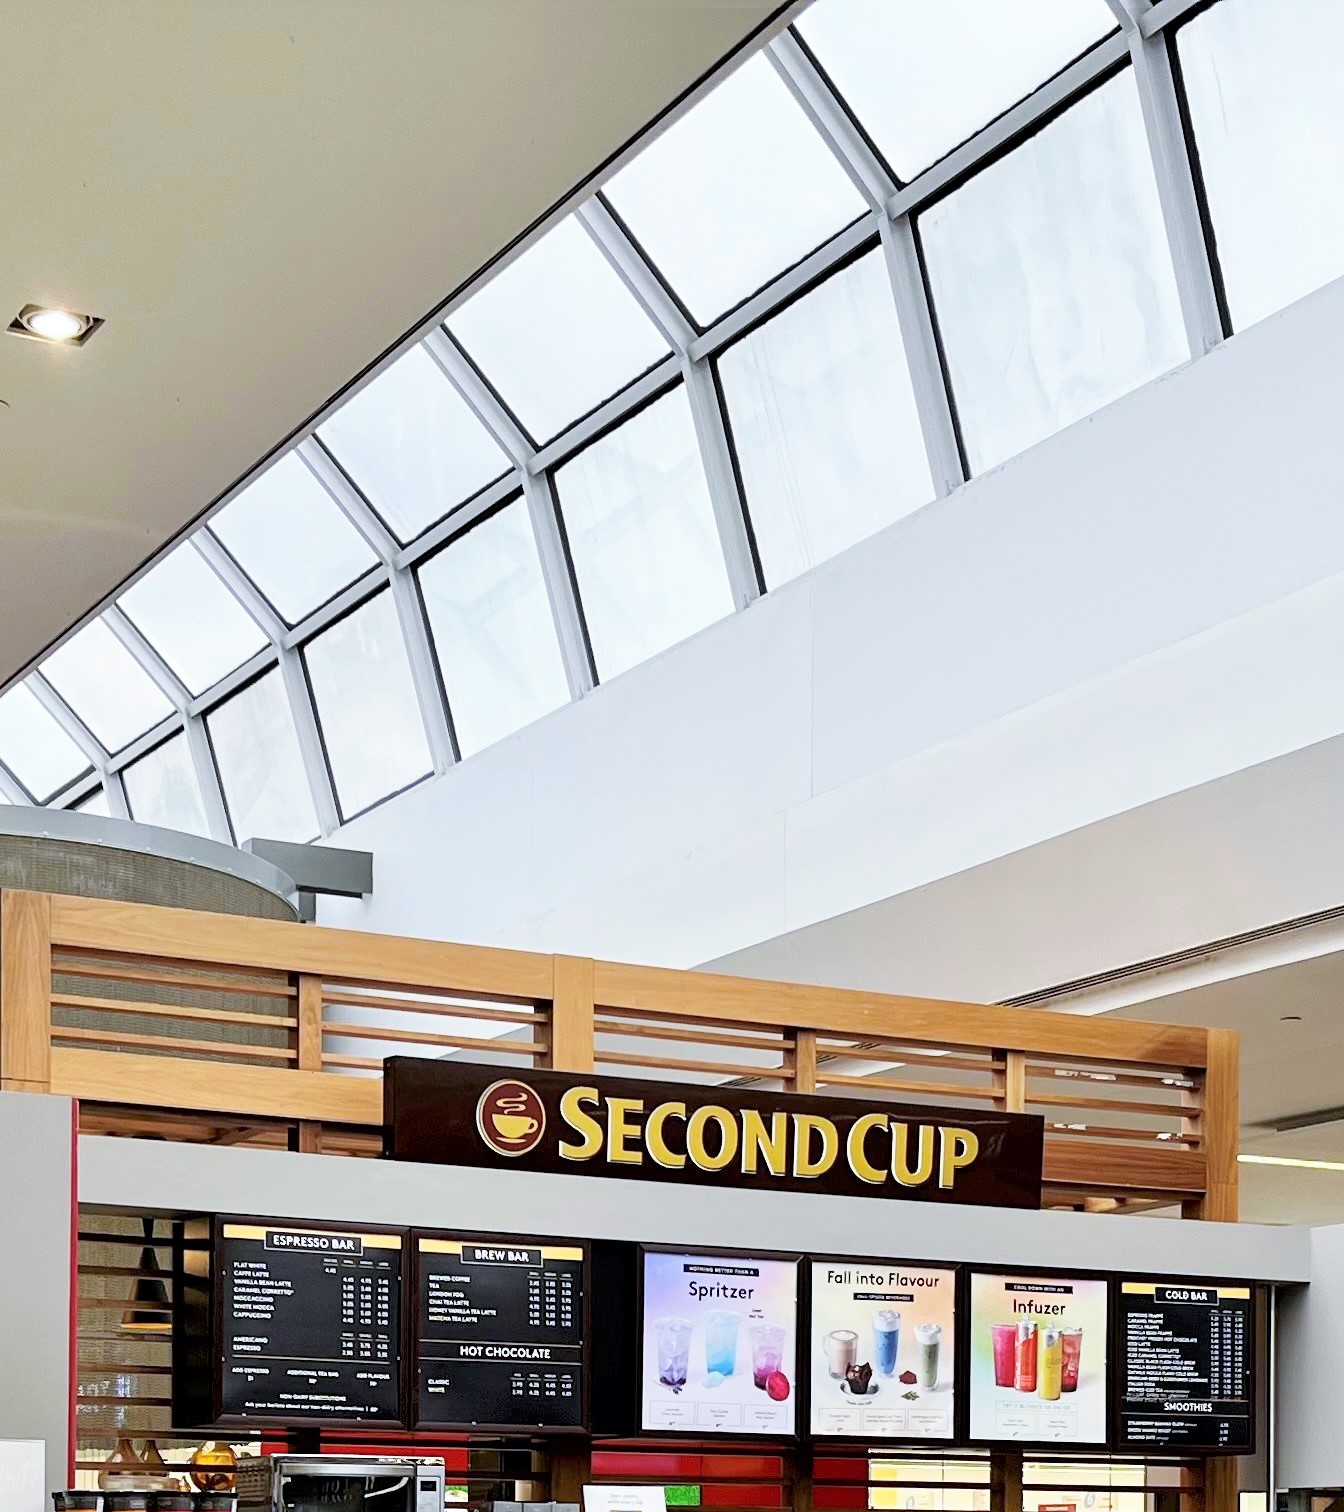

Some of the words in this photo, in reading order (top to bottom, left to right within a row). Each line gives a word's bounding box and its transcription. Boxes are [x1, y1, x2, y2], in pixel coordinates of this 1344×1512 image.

[557, 1086, 838, 1179] SECOND
[846, 1113, 979, 1190] CUP
[273, 1235, 329, 1249] ESPRESSO
[332, 1240, 355, 1250] BAR
[475, 1250, 505, 1260] BREW
[508, 1252, 529, 1262] BAR
[827, 1270, 851, 1284] Fall
[856, 1271, 884, 1285] into
[889, 1273, 939, 1287] Flavour
[689, 1281, 754, 1301] Spritzer
[1165, 1290, 1189, 1300] COLD
[1190, 1291, 1208, 1300] BAR
[1013, 1299, 1066, 1315] Infuzer
[460, 1346, 483, 1357] HOT
[485, 1347, 550, 1359] CHOCOLATE
[1164, 1402, 1213, 1412] SMOOTHIES
